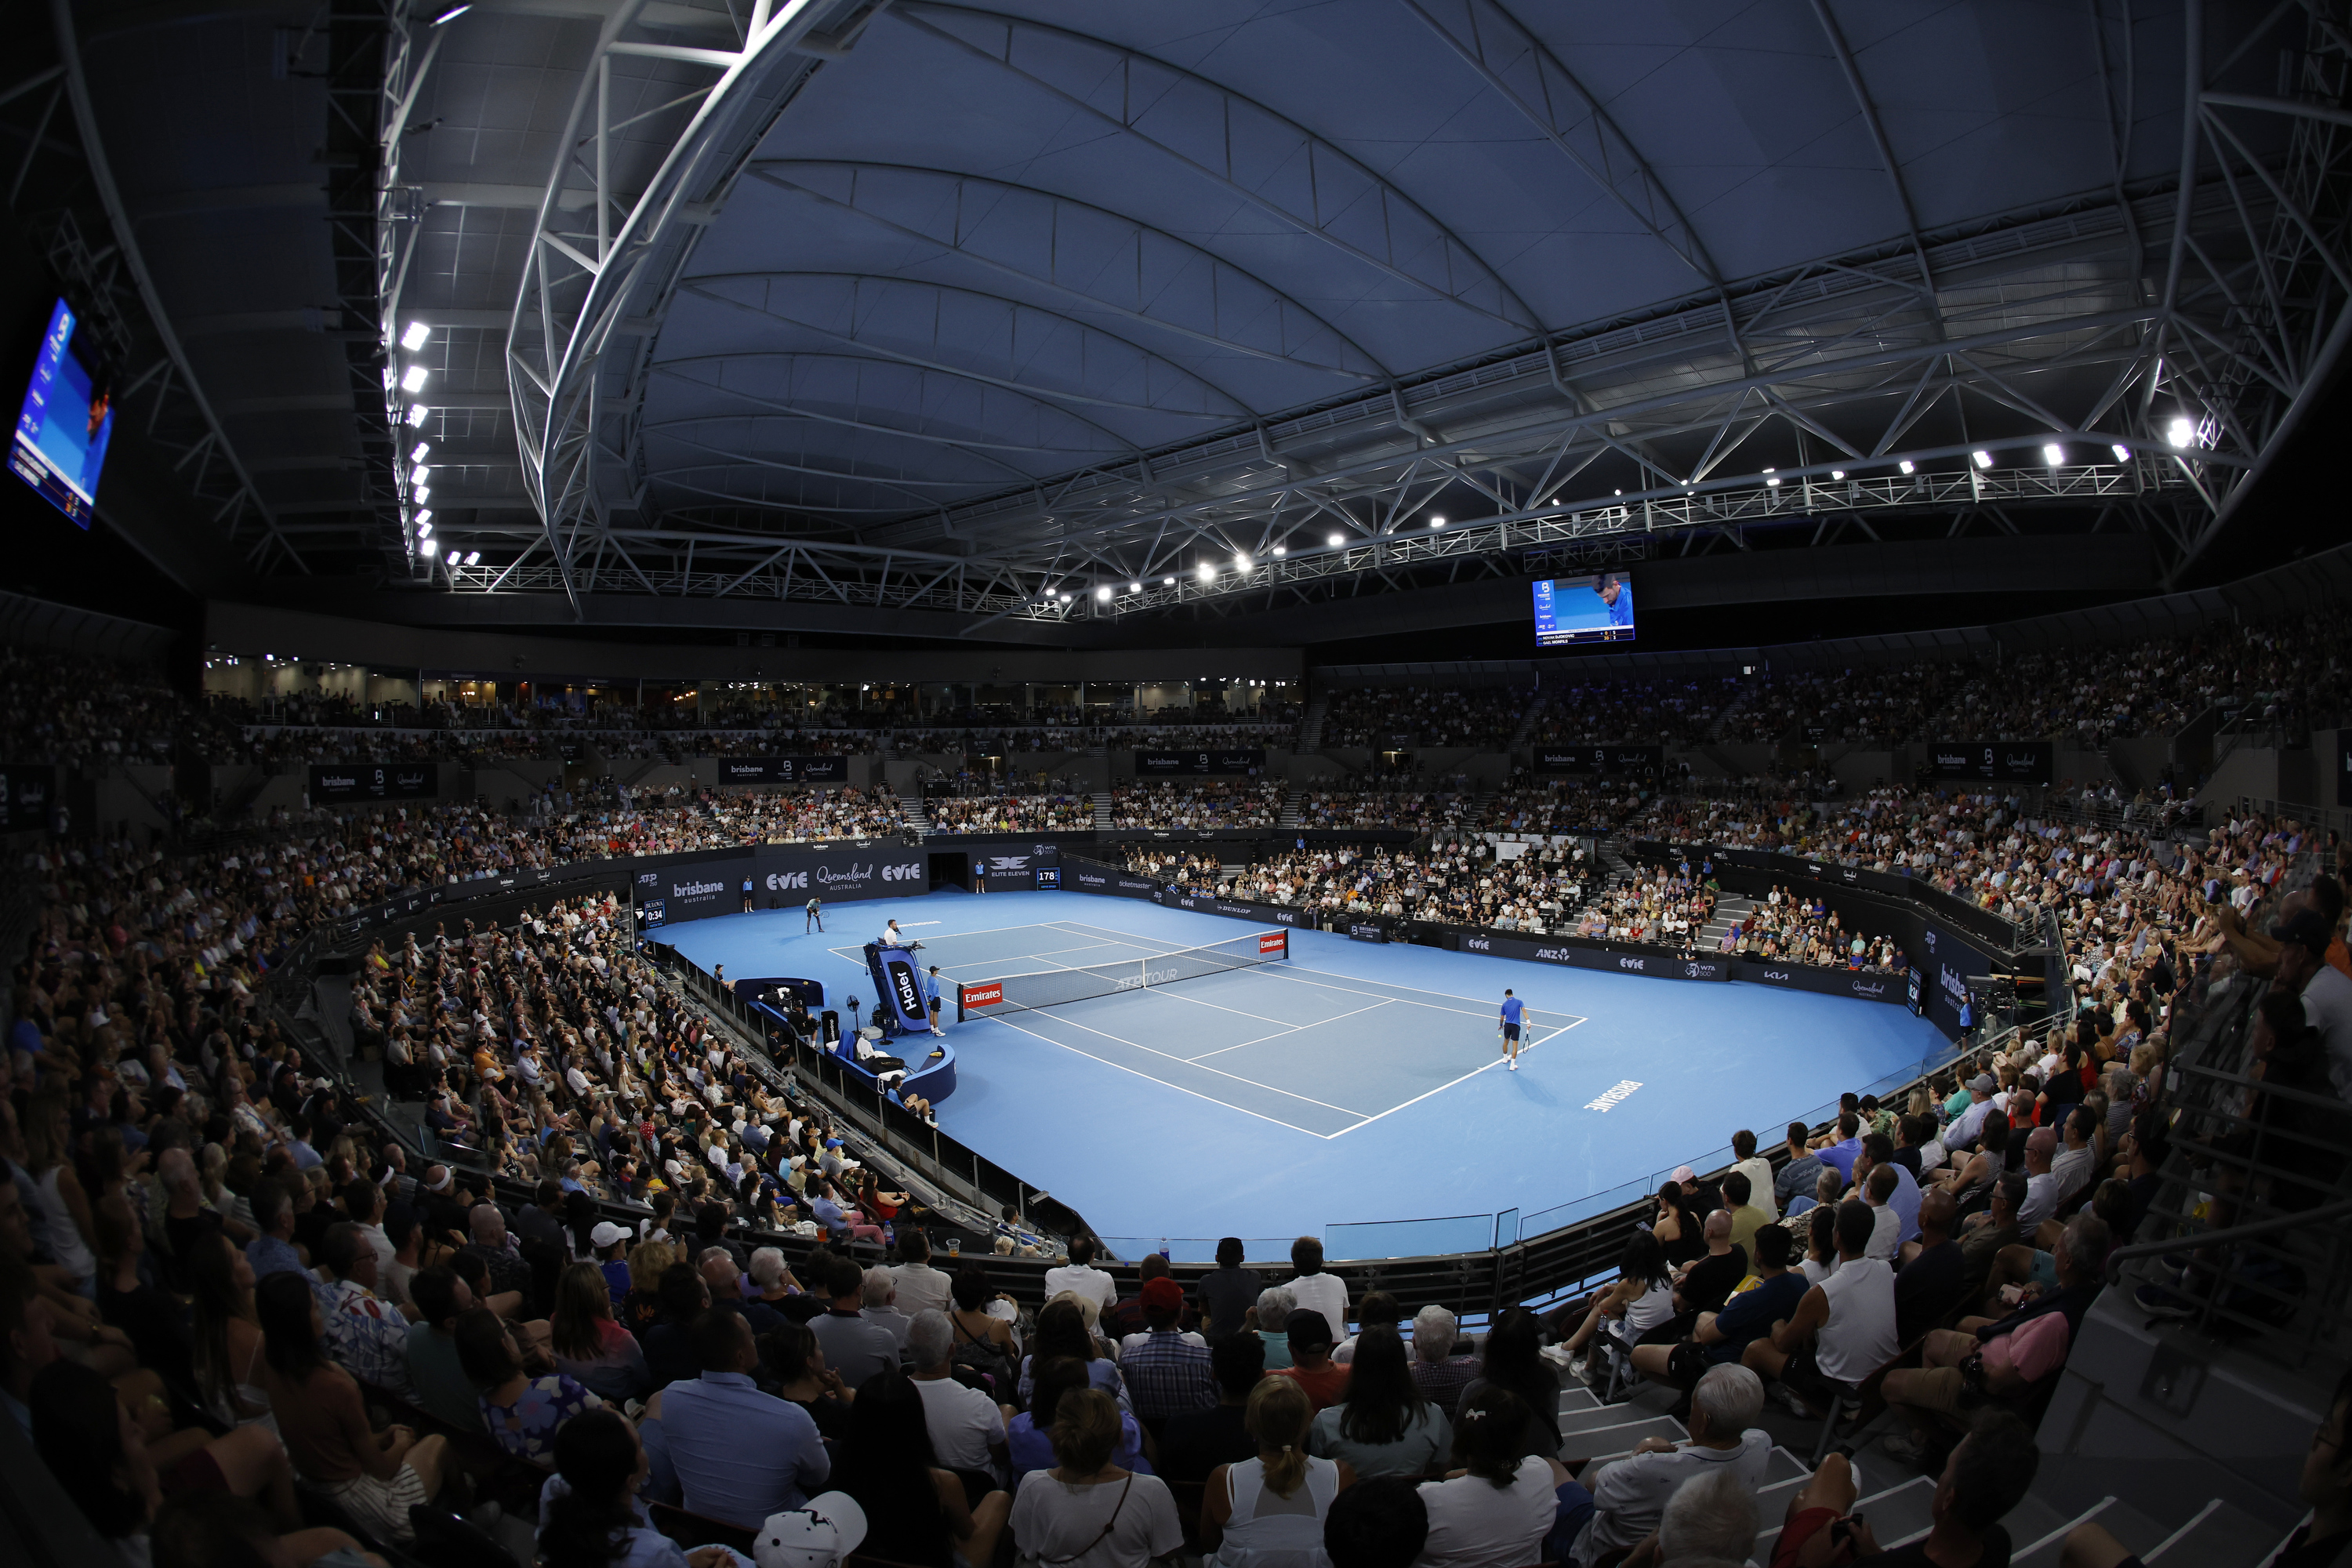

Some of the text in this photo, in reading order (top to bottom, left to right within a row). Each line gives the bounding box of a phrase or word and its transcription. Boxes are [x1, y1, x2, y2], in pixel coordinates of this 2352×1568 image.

[1222, 757, 1250, 765] Queensland
[1938, 754, 1966, 764] brisbane
[2007, 753, 2035, 767] Queensland
[731, 765, 763, 773] brisbane
[806, 763, 833, 772] Queensland
[322, 776, 355, 786] brisbane
[817, 863, 873, 883] Queensland
[1039, 872, 1055, 880] 178
[638, 873, 657, 884] ATP
[1079, 874, 1105, 884] brisbane
[674, 881, 724, 897] brisbane
[1119, 880, 1151, 889] ticketmaster
[684, 895, 715, 904] australia
[1223, 906, 1251, 914] DUNLOP
[648, 910, 662, 921] 0:34
[1261, 938, 1284, 948] Emirates
[1535, 948, 1558, 959] ANZ
[1114, 968, 1178, 990] ATP TOUR
[897, 972, 917, 1011] Haier
[1852, 980, 1884, 994] Queensland
[965, 990, 1001, 1003] Emirates
[1583, 1080, 1644, 1113] BRISBANE
